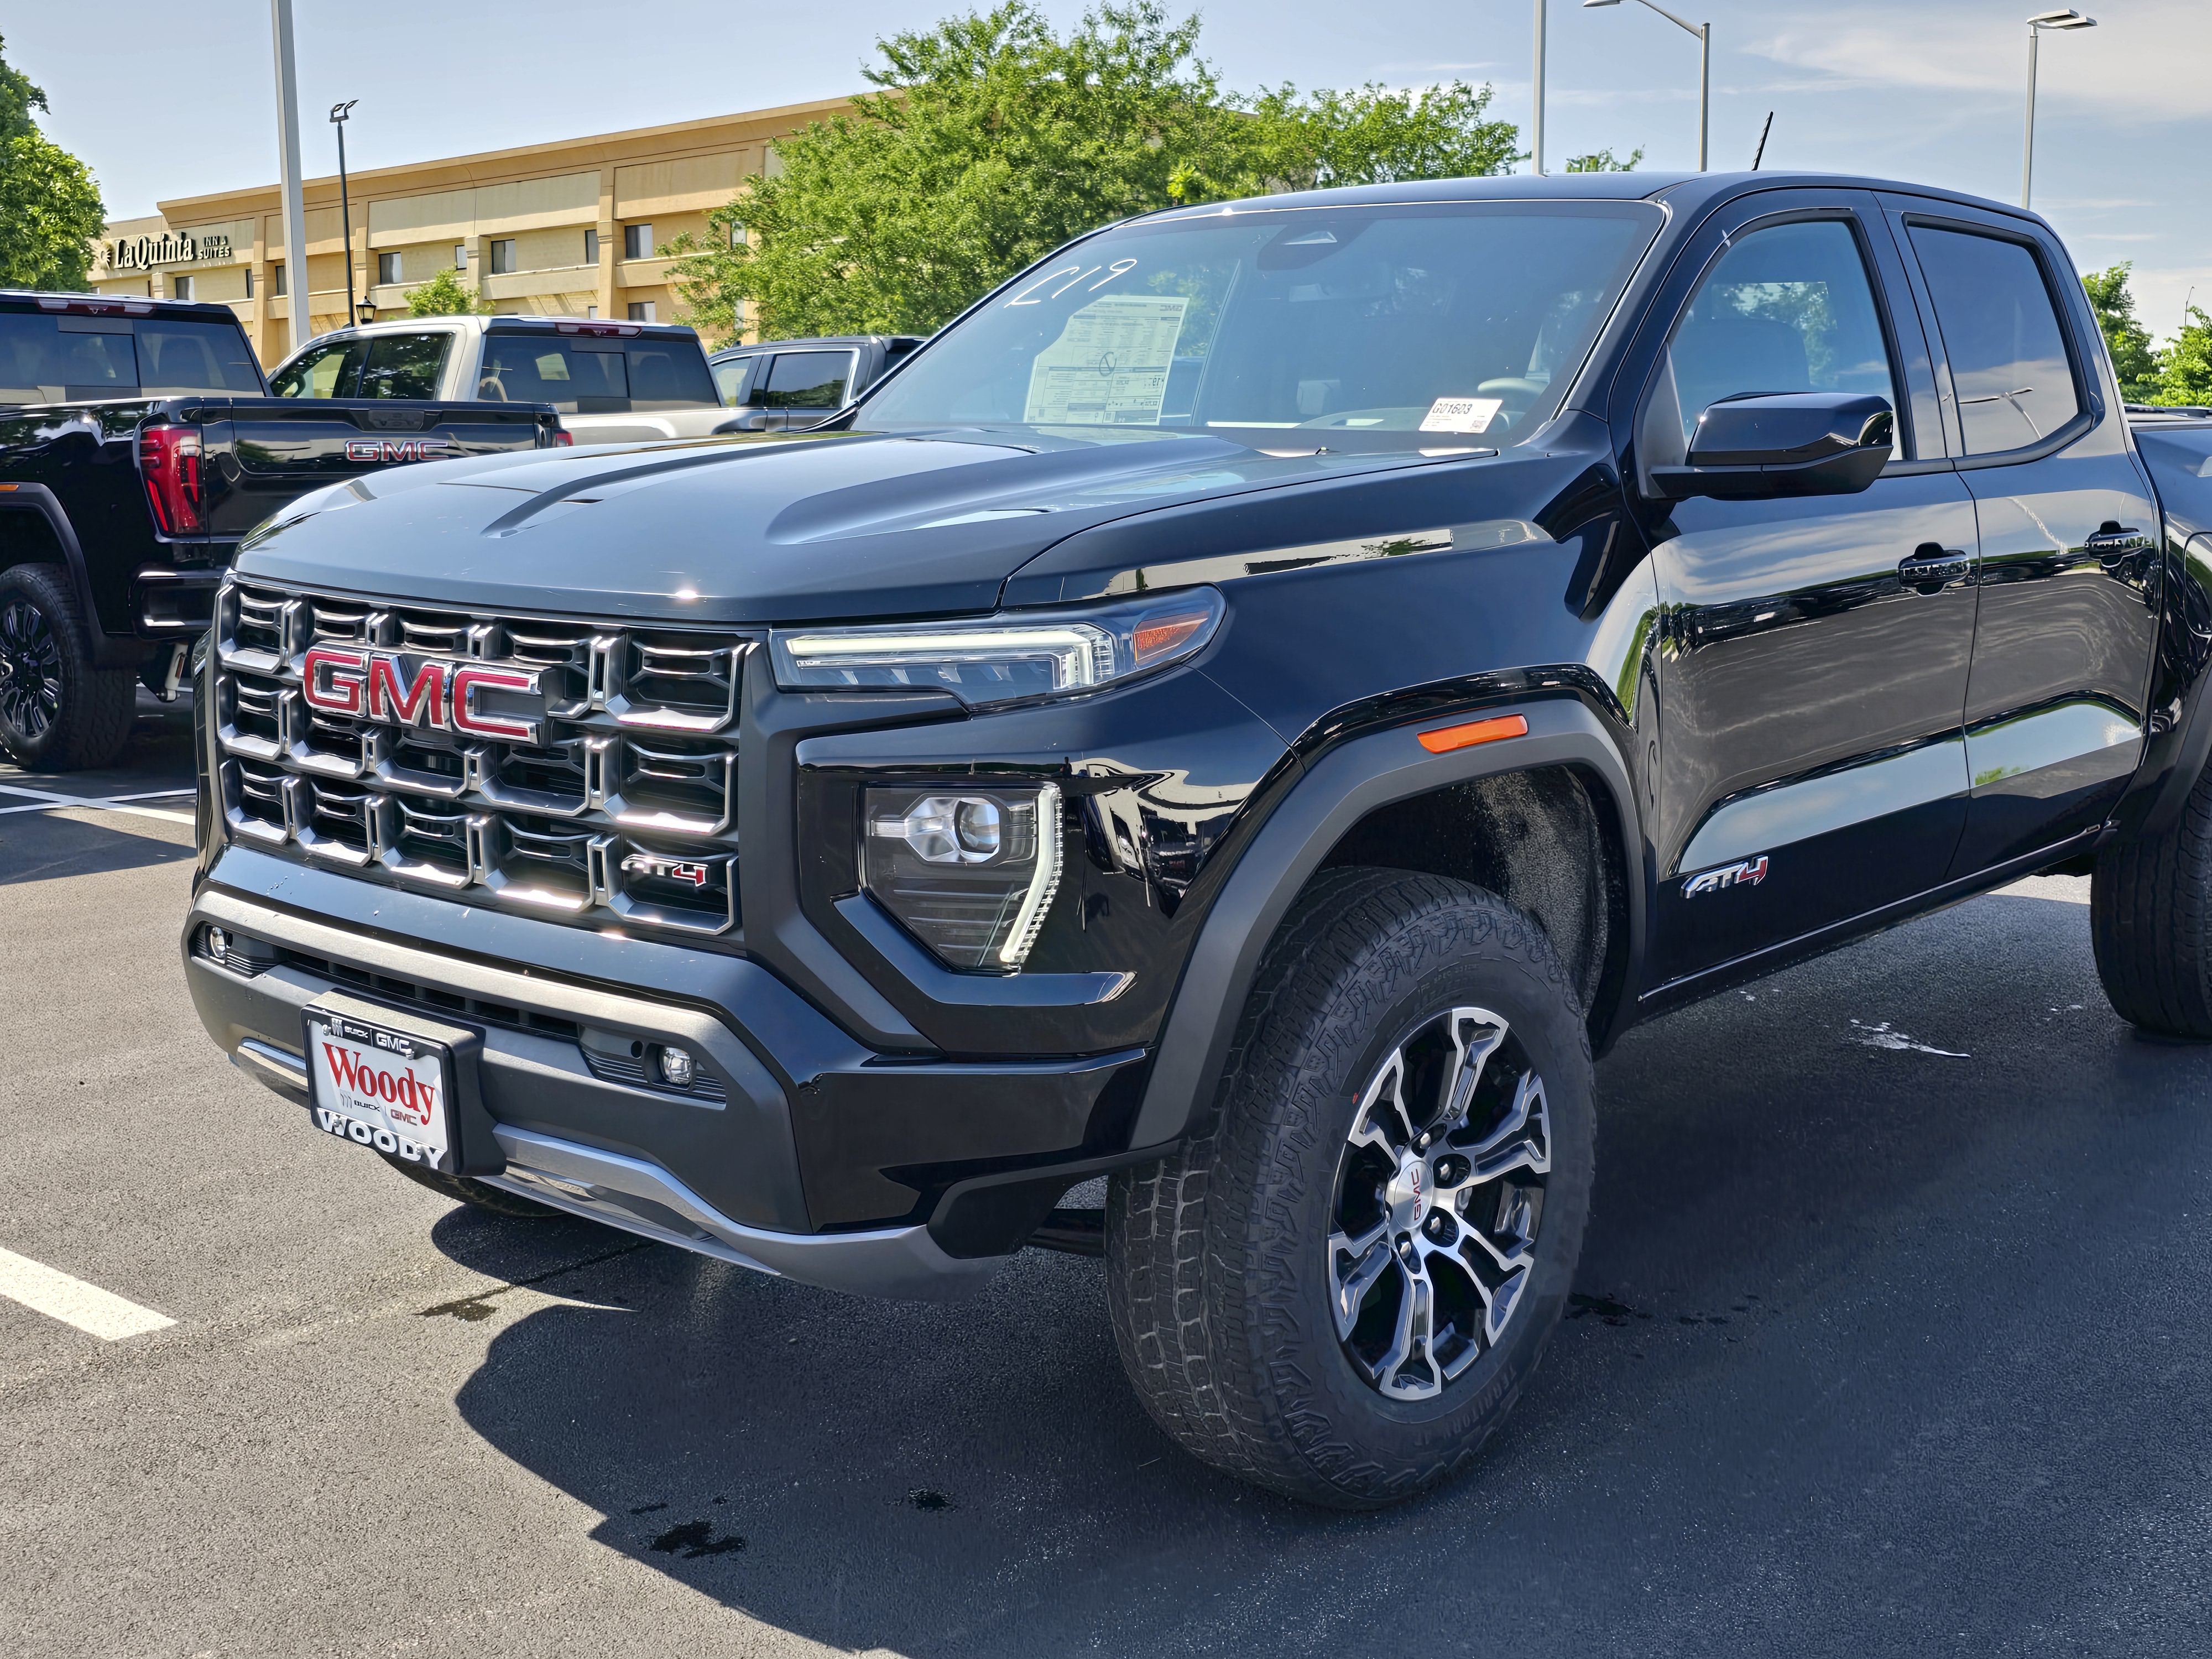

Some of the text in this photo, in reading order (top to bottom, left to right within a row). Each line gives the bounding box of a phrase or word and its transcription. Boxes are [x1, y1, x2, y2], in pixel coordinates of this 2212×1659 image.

[198, 247, 232, 260] SUITES
[204, 236, 220, 247] INN
[346, 440, 449, 461] GMC
[303, 643, 542, 745] GMC
[1680, 855, 1768, 899] AT4
[345, 1026, 410, 1053] BUICK GMC
[322, 1042, 435, 1126] Woody
[354, 1100, 418, 1126] BUICK GMC
[317, 1109, 445, 1170] WOODY
[1411, 1168, 1422, 1221] GMC
